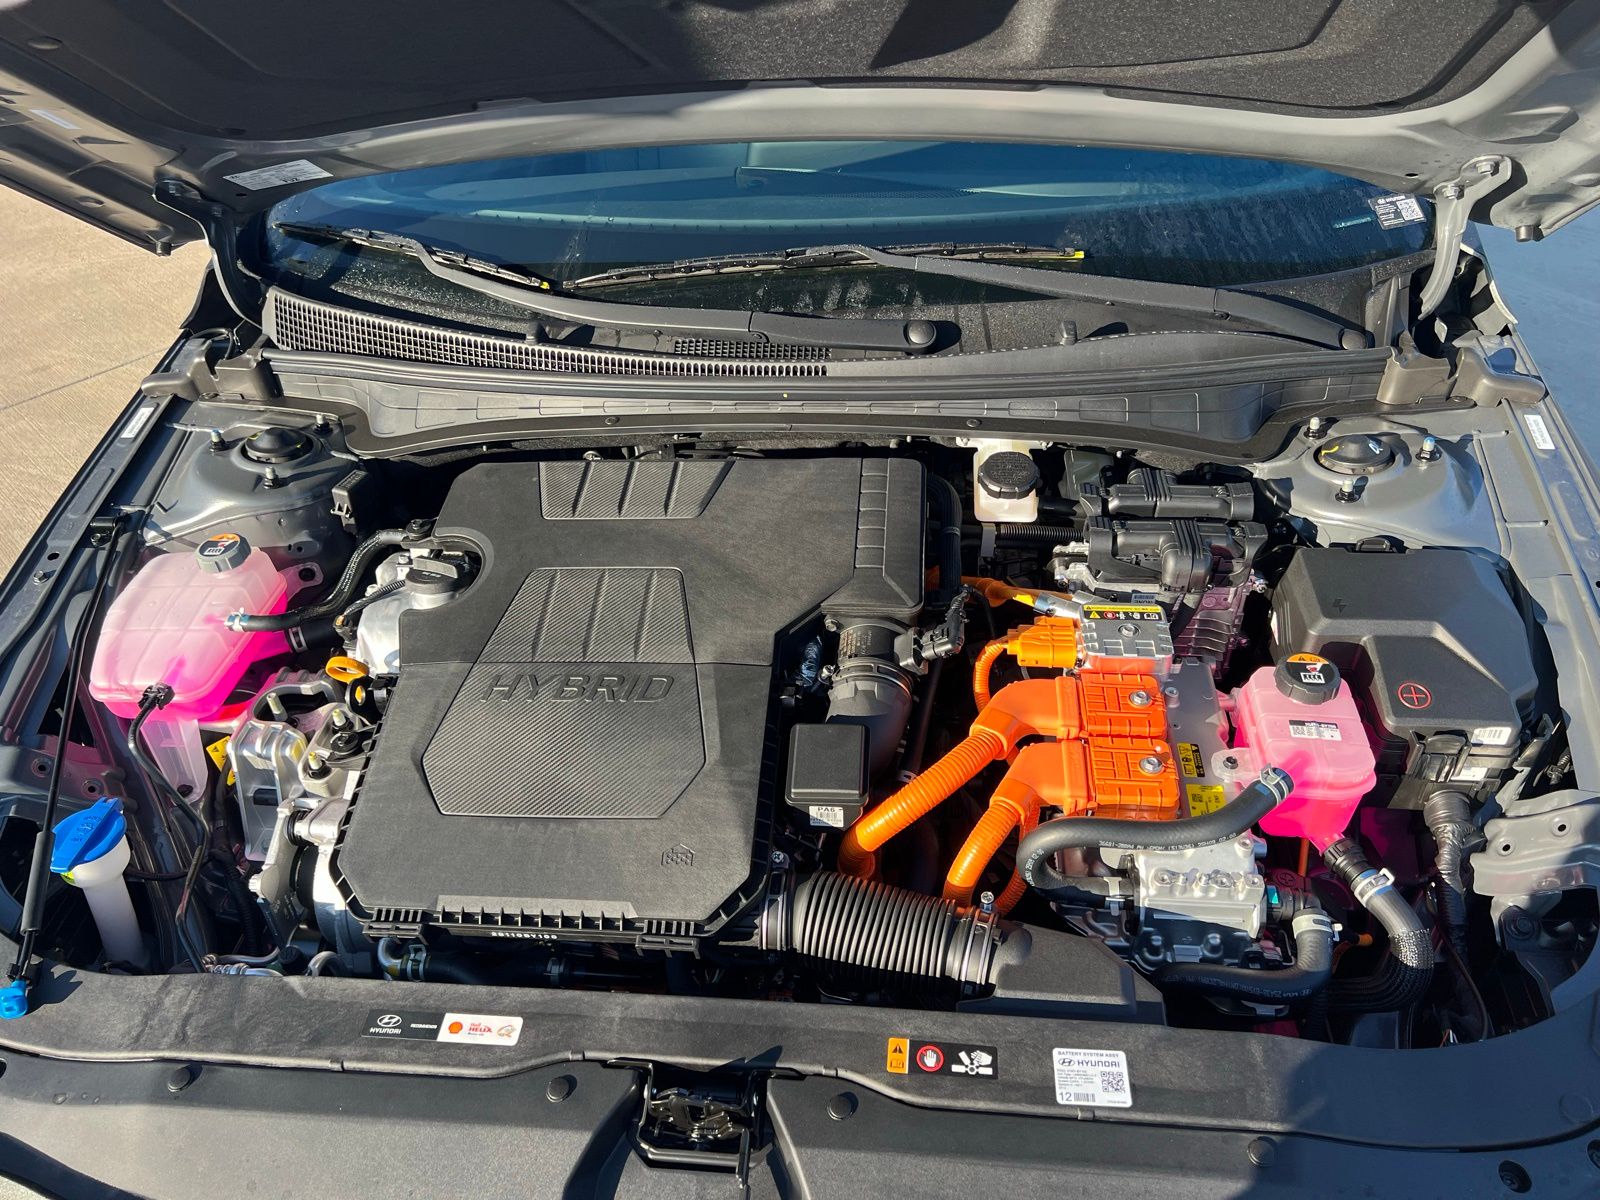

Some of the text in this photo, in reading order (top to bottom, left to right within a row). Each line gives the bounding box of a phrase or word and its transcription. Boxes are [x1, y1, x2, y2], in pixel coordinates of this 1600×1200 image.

[479, 674, 675, 703] HYBRID
[369, 1027, 402, 1035] HYUNDAI
[1077, 1060, 1120, 1068] HYUNDAI
[1059, 1092, 1072, 1102] 12
